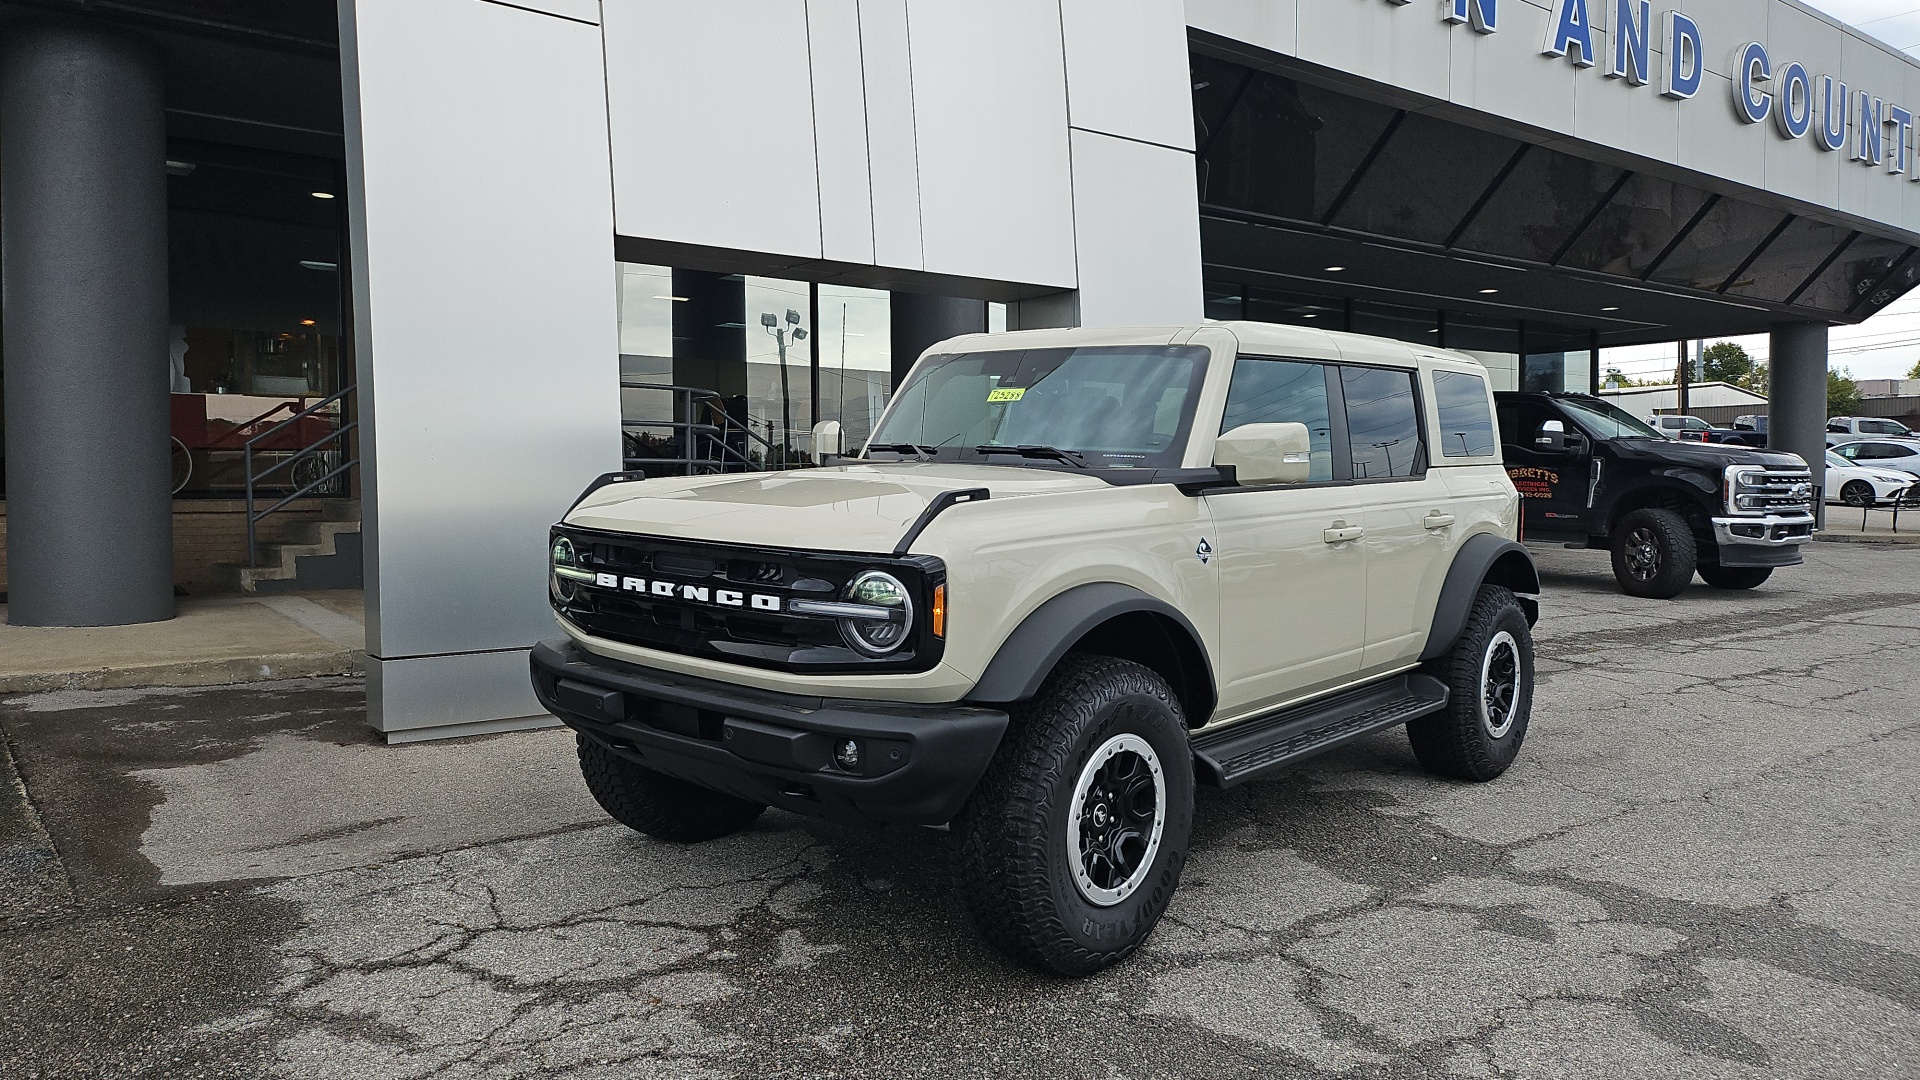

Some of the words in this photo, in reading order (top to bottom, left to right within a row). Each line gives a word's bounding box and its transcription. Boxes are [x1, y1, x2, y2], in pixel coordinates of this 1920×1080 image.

[1542, 0, 1705, 100] AND
[1731, 40, 1920, 182] COUNT
[596, 573, 781, 612] BRONCO
